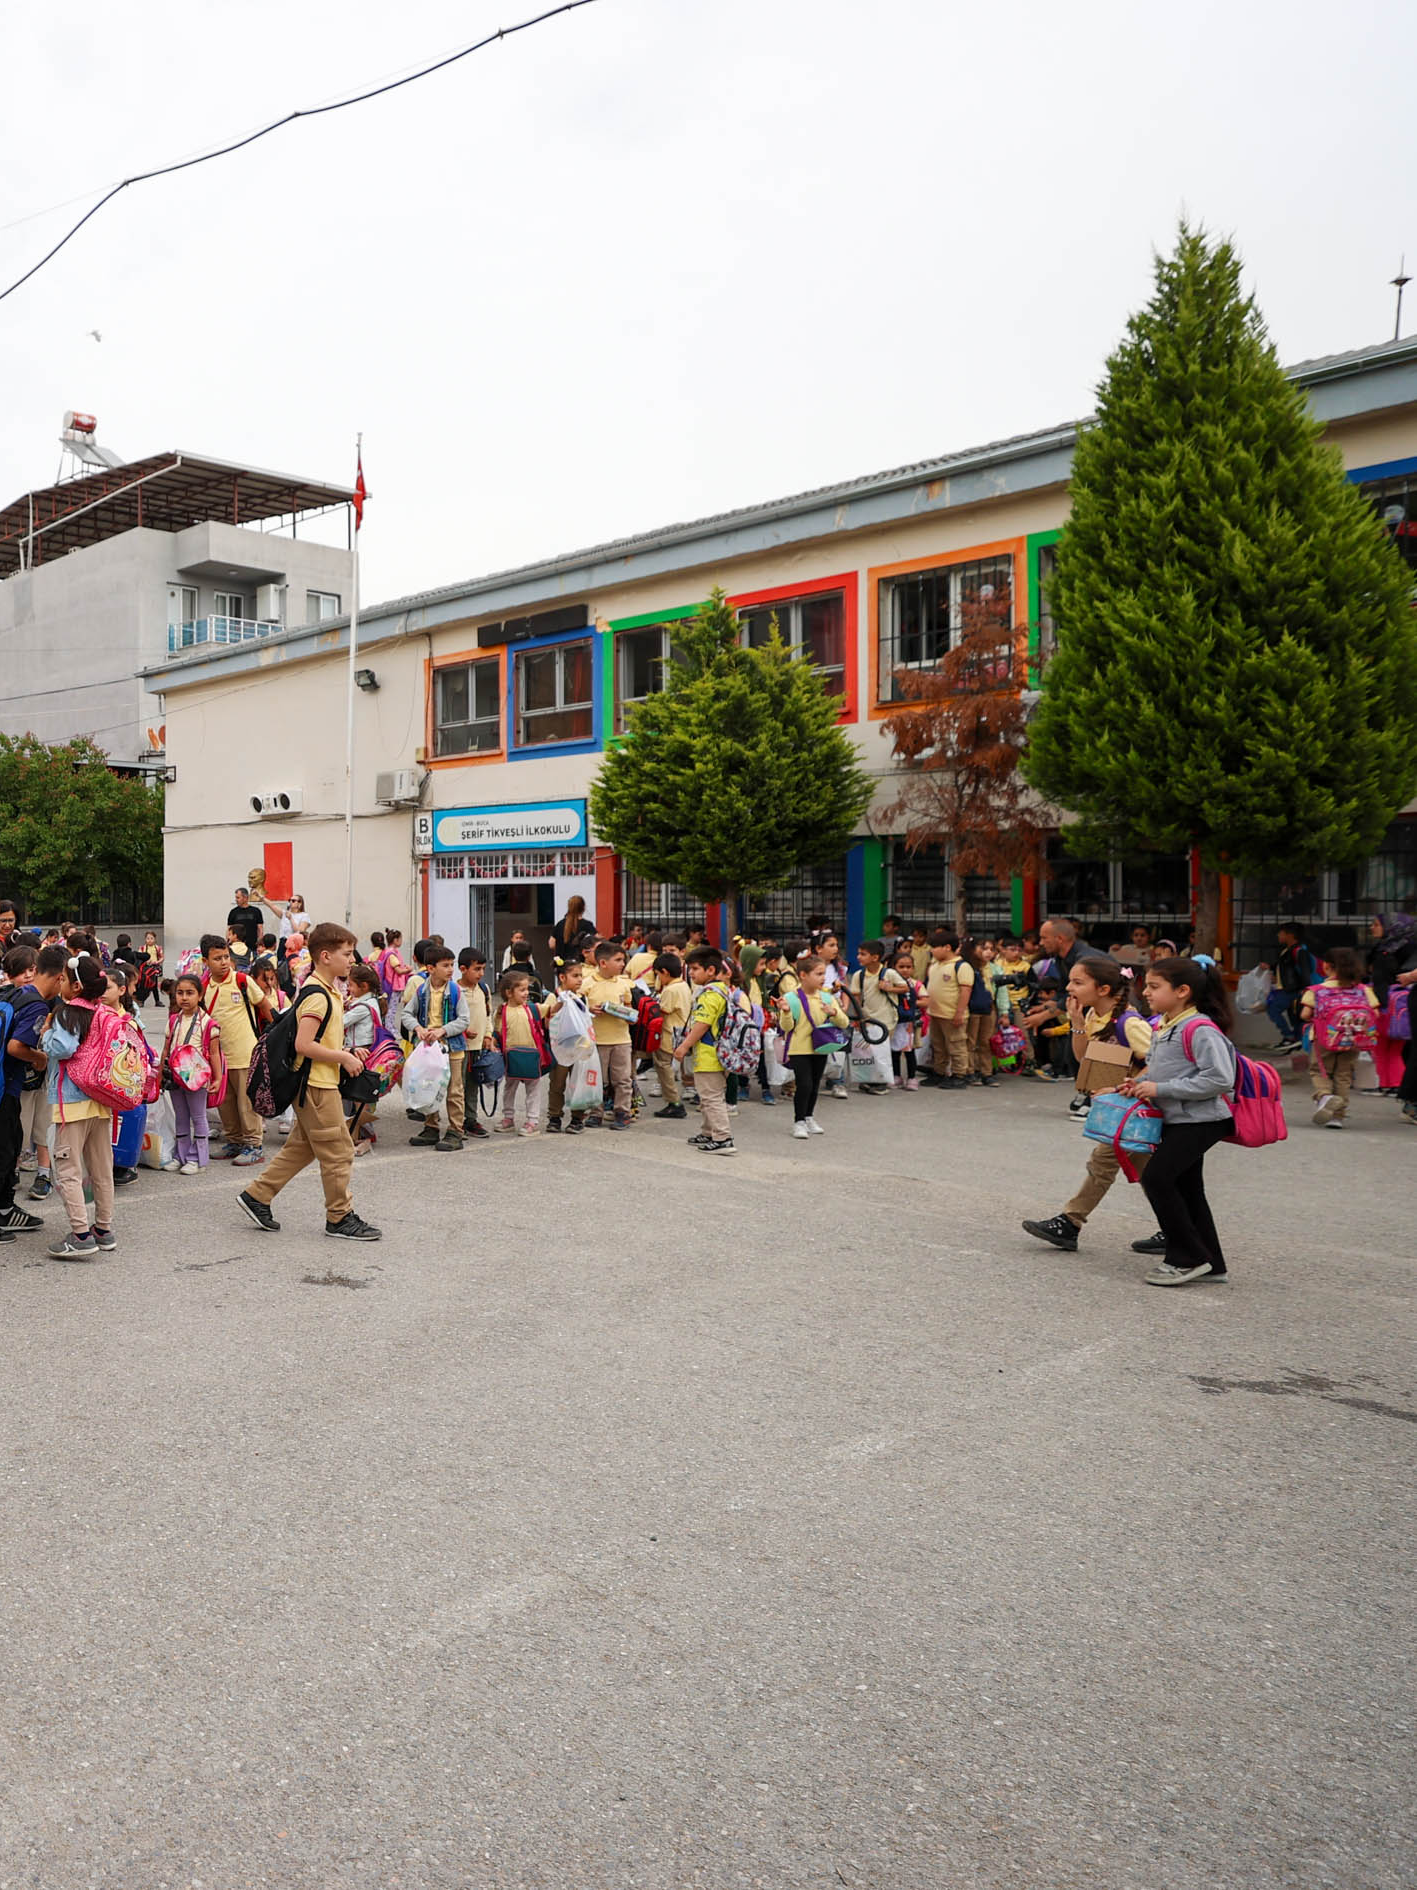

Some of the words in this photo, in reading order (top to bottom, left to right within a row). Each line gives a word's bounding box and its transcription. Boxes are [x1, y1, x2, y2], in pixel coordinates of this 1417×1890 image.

[419, 818, 429, 834] B
[461, 829, 485, 840] ŞERİF
[486, 825, 524, 838] TİKVEŞLİ
[526, 824, 571, 836] İLKOKULU
